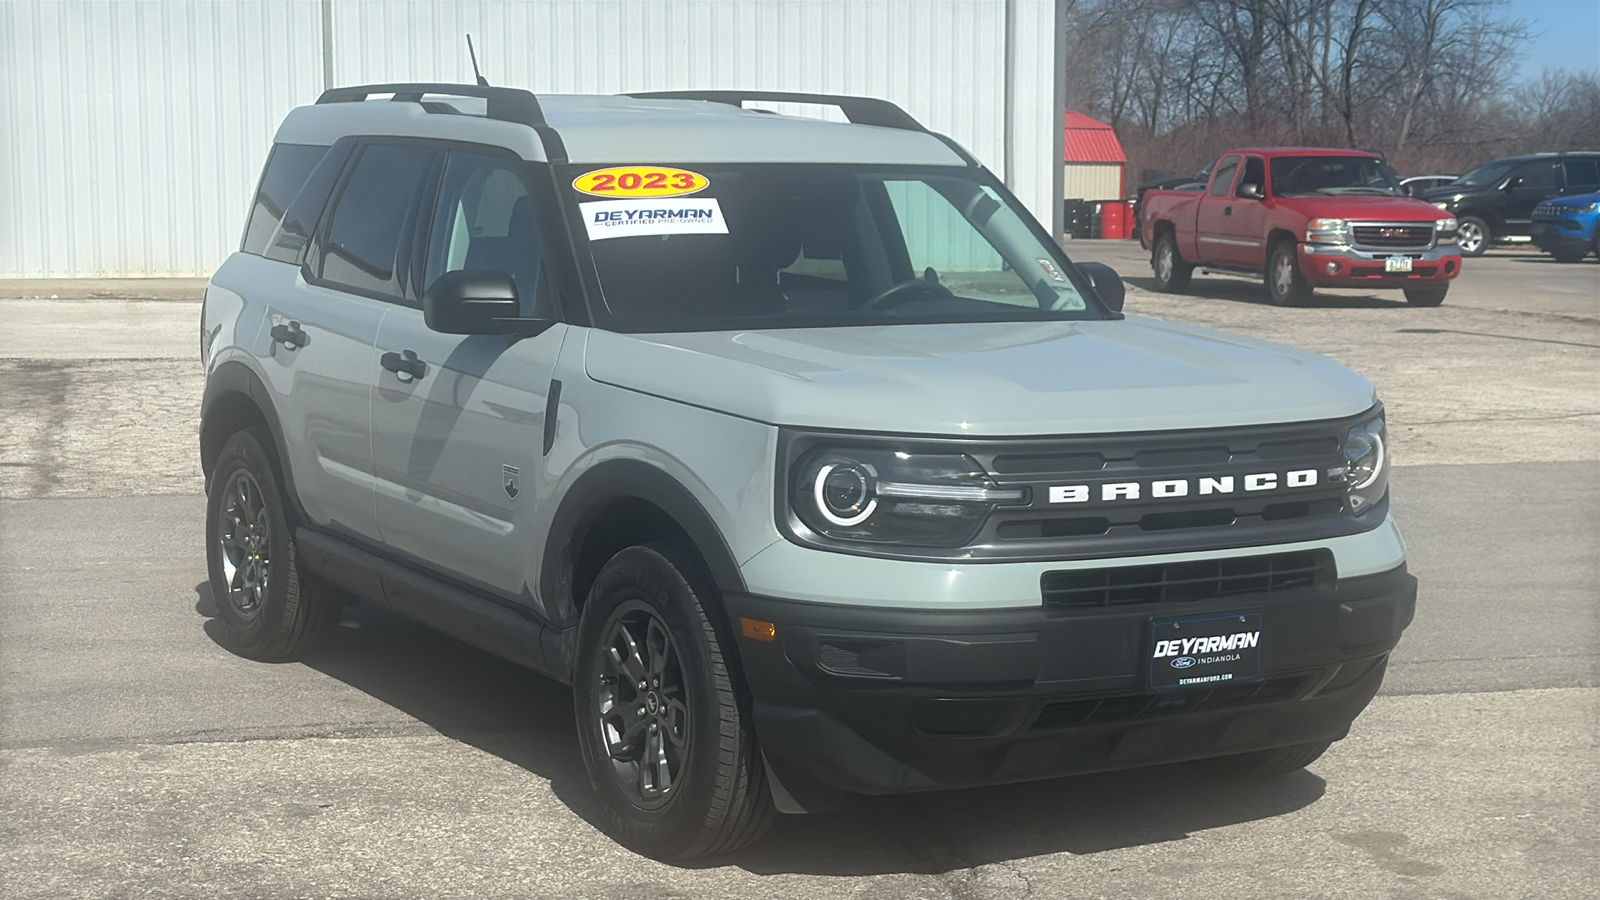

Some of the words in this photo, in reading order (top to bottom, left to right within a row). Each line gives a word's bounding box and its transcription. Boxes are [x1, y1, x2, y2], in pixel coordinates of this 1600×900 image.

[590, 173, 696, 191] 2023
[594, 209, 713, 223] DEYARMAN
[1049, 469, 1318, 503] BRONCO
[1153, 631, 1260, 658] DEYARMAN
[1175, 657, 1192, 667] Ford
[1198, 654, 1241, 664] INDIANOLA
[1179, 674, 1233, 684] DEYARMANFORD.COM
